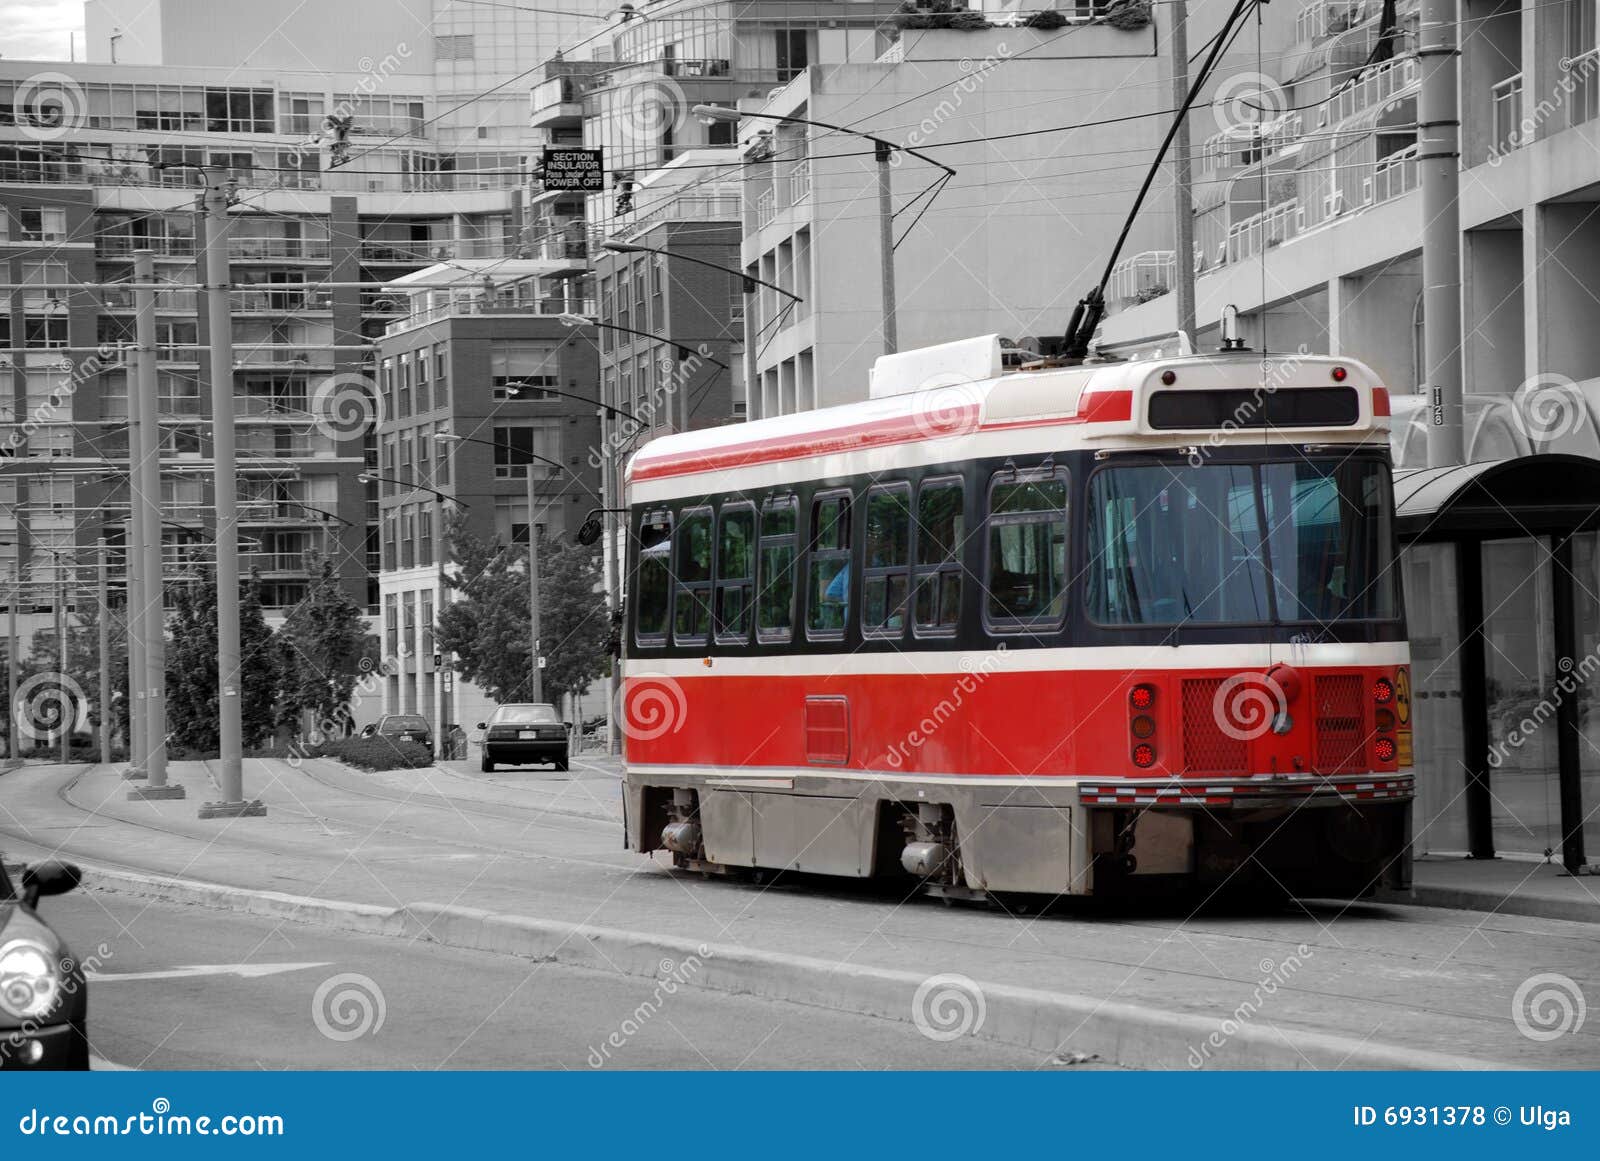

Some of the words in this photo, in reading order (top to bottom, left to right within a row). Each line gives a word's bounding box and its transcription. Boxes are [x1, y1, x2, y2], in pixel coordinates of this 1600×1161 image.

[552, 152, 594, 161] SECTION
[547, 161, 600, 170] INSULATOR
[586, 170, 601, 178] with
[545, 178, 580, 187] POWER
[583, 178, 602, 187] OFF
